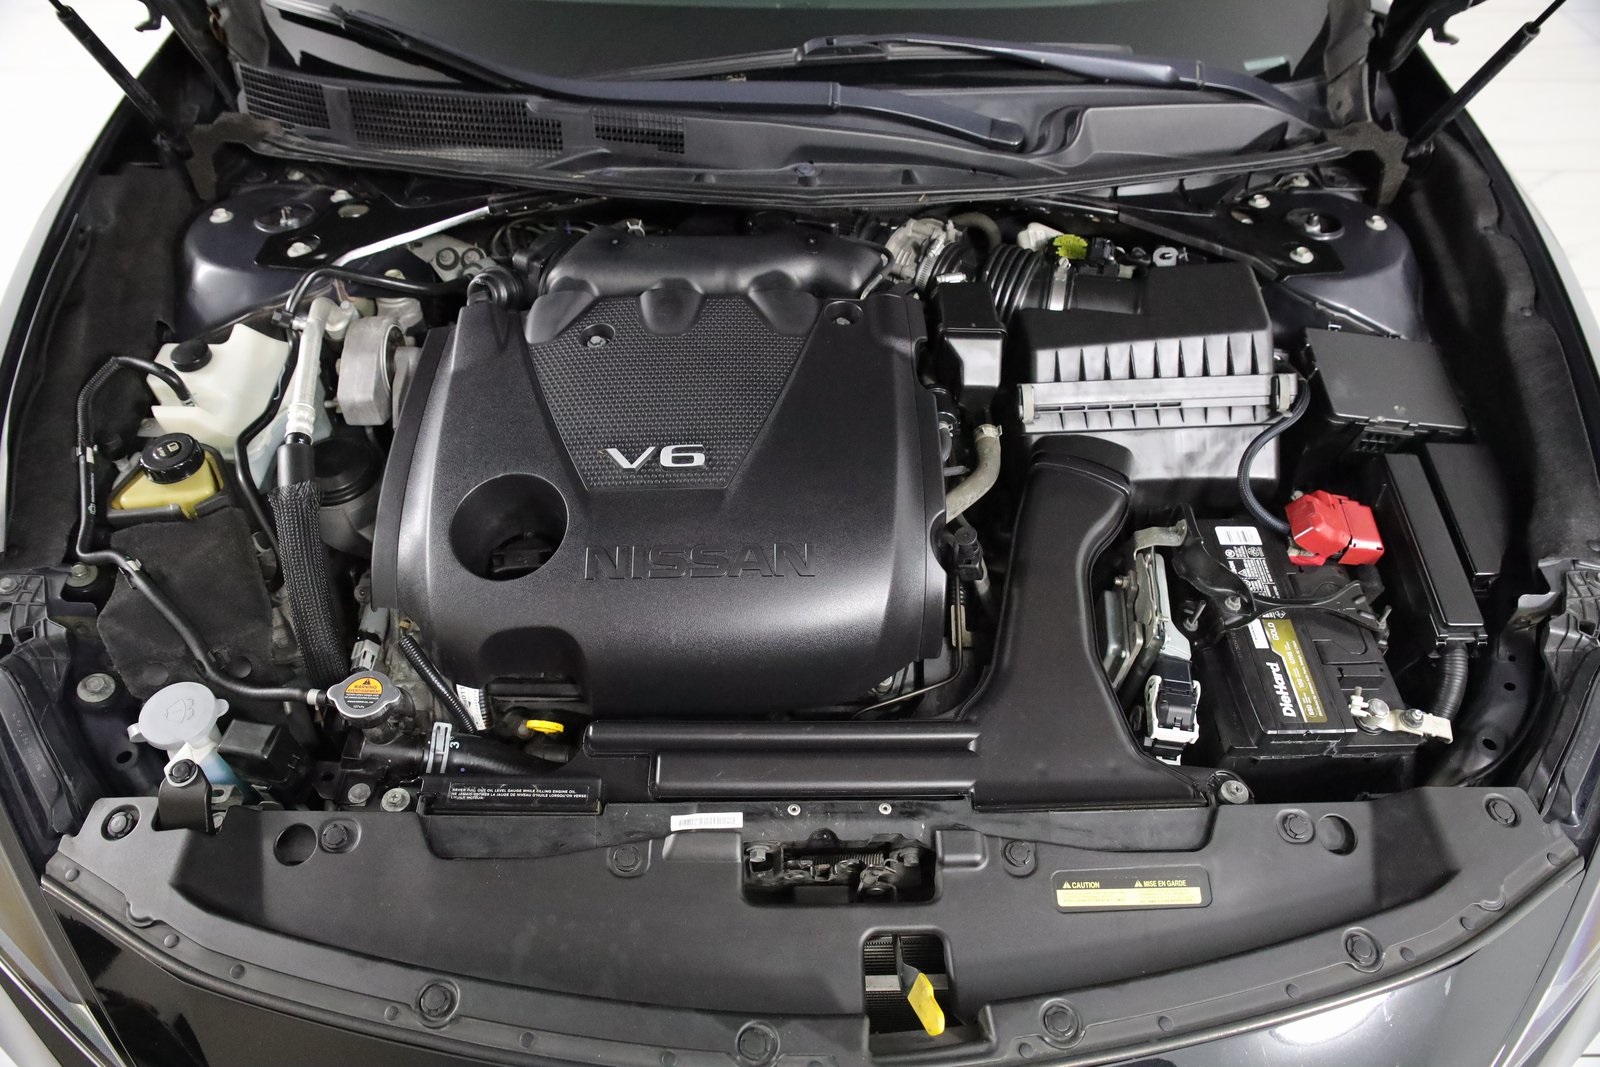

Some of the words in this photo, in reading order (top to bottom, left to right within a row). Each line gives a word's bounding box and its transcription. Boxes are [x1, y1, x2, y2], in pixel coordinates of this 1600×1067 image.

[605, 443, 706, 471] V6
[584, 543, 816, 580] NISSAN
[1267, 621, 1280, 641] GOLD
[1265, 661, 1297, 718] DieHard
[449, 741, 460, 749] 3
[1071, 881, 1100, 889] CAUTION
